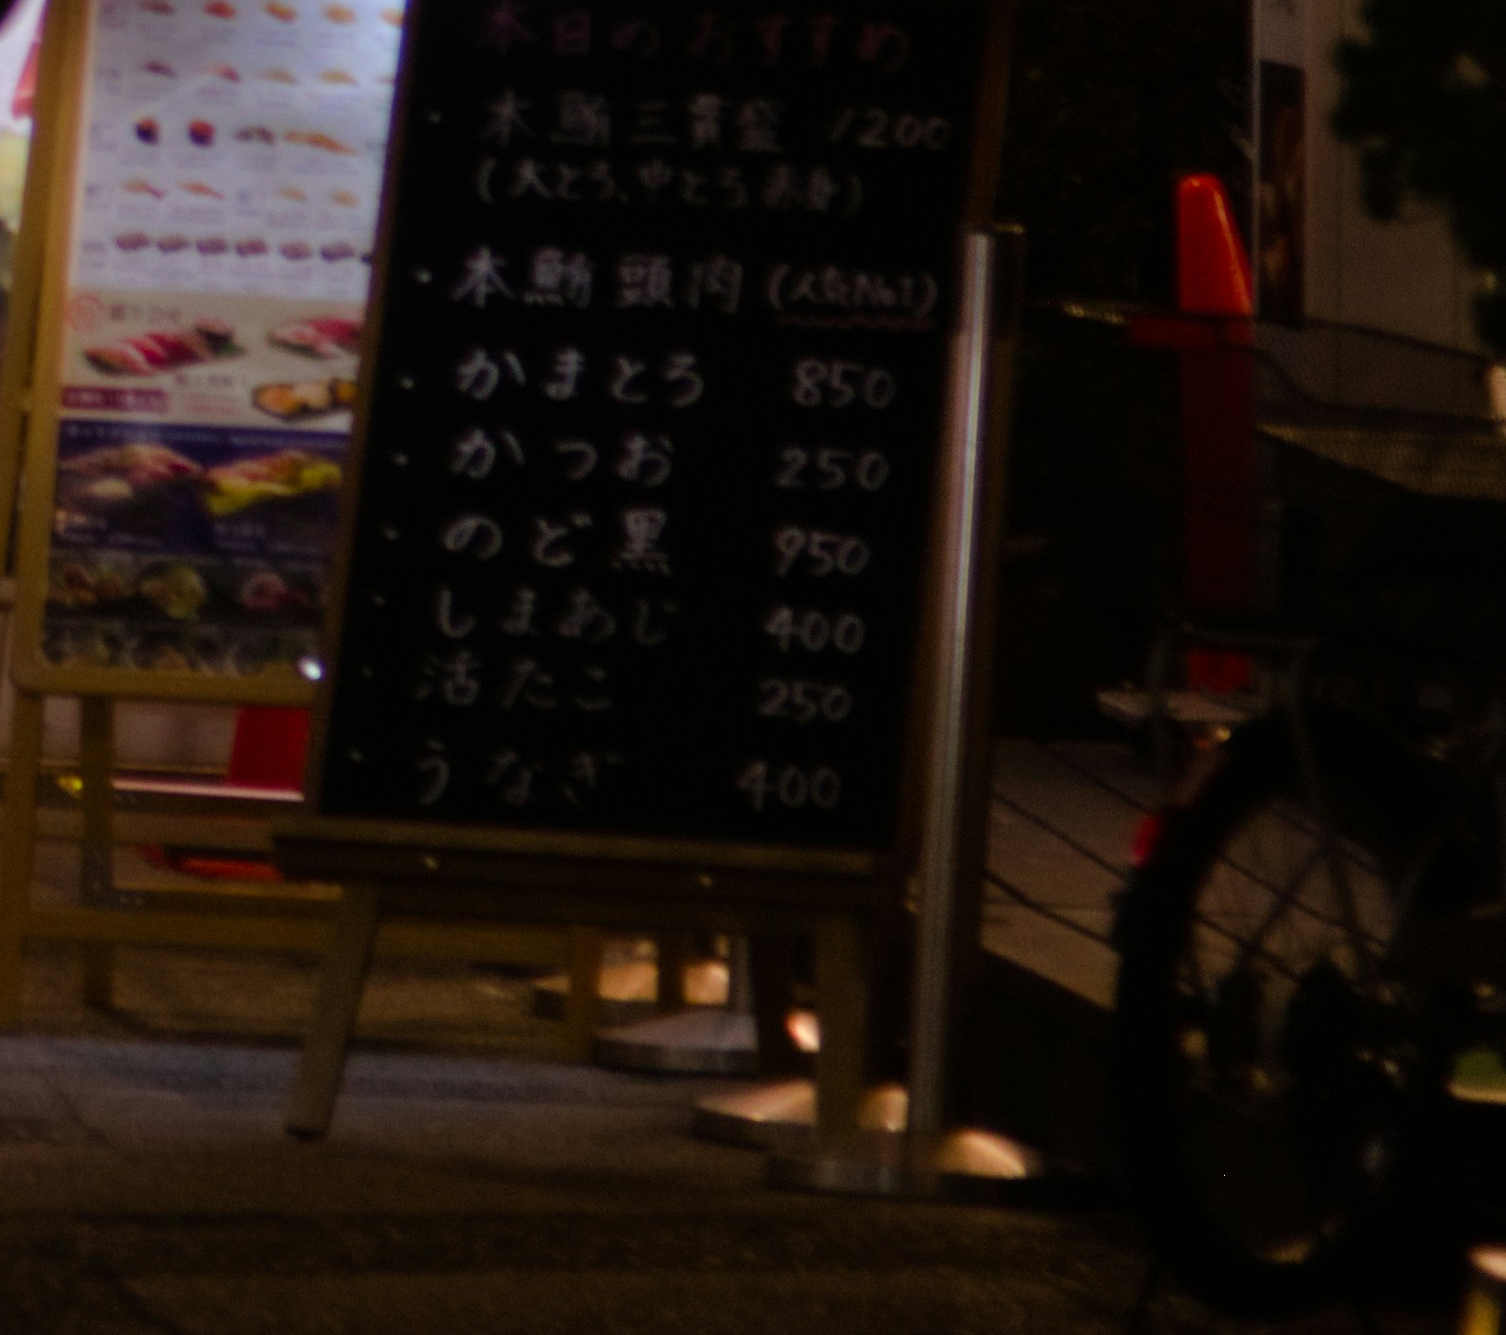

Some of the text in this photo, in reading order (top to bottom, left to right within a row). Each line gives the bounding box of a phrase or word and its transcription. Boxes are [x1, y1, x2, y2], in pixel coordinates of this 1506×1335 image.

[790, 355, 897, 410] 850
[448, 424, 676, 488] かつお
[768, 522, 872, 578] 950
[761, 602, 866, 655] 400
[734, 757, 843, 813] 400
